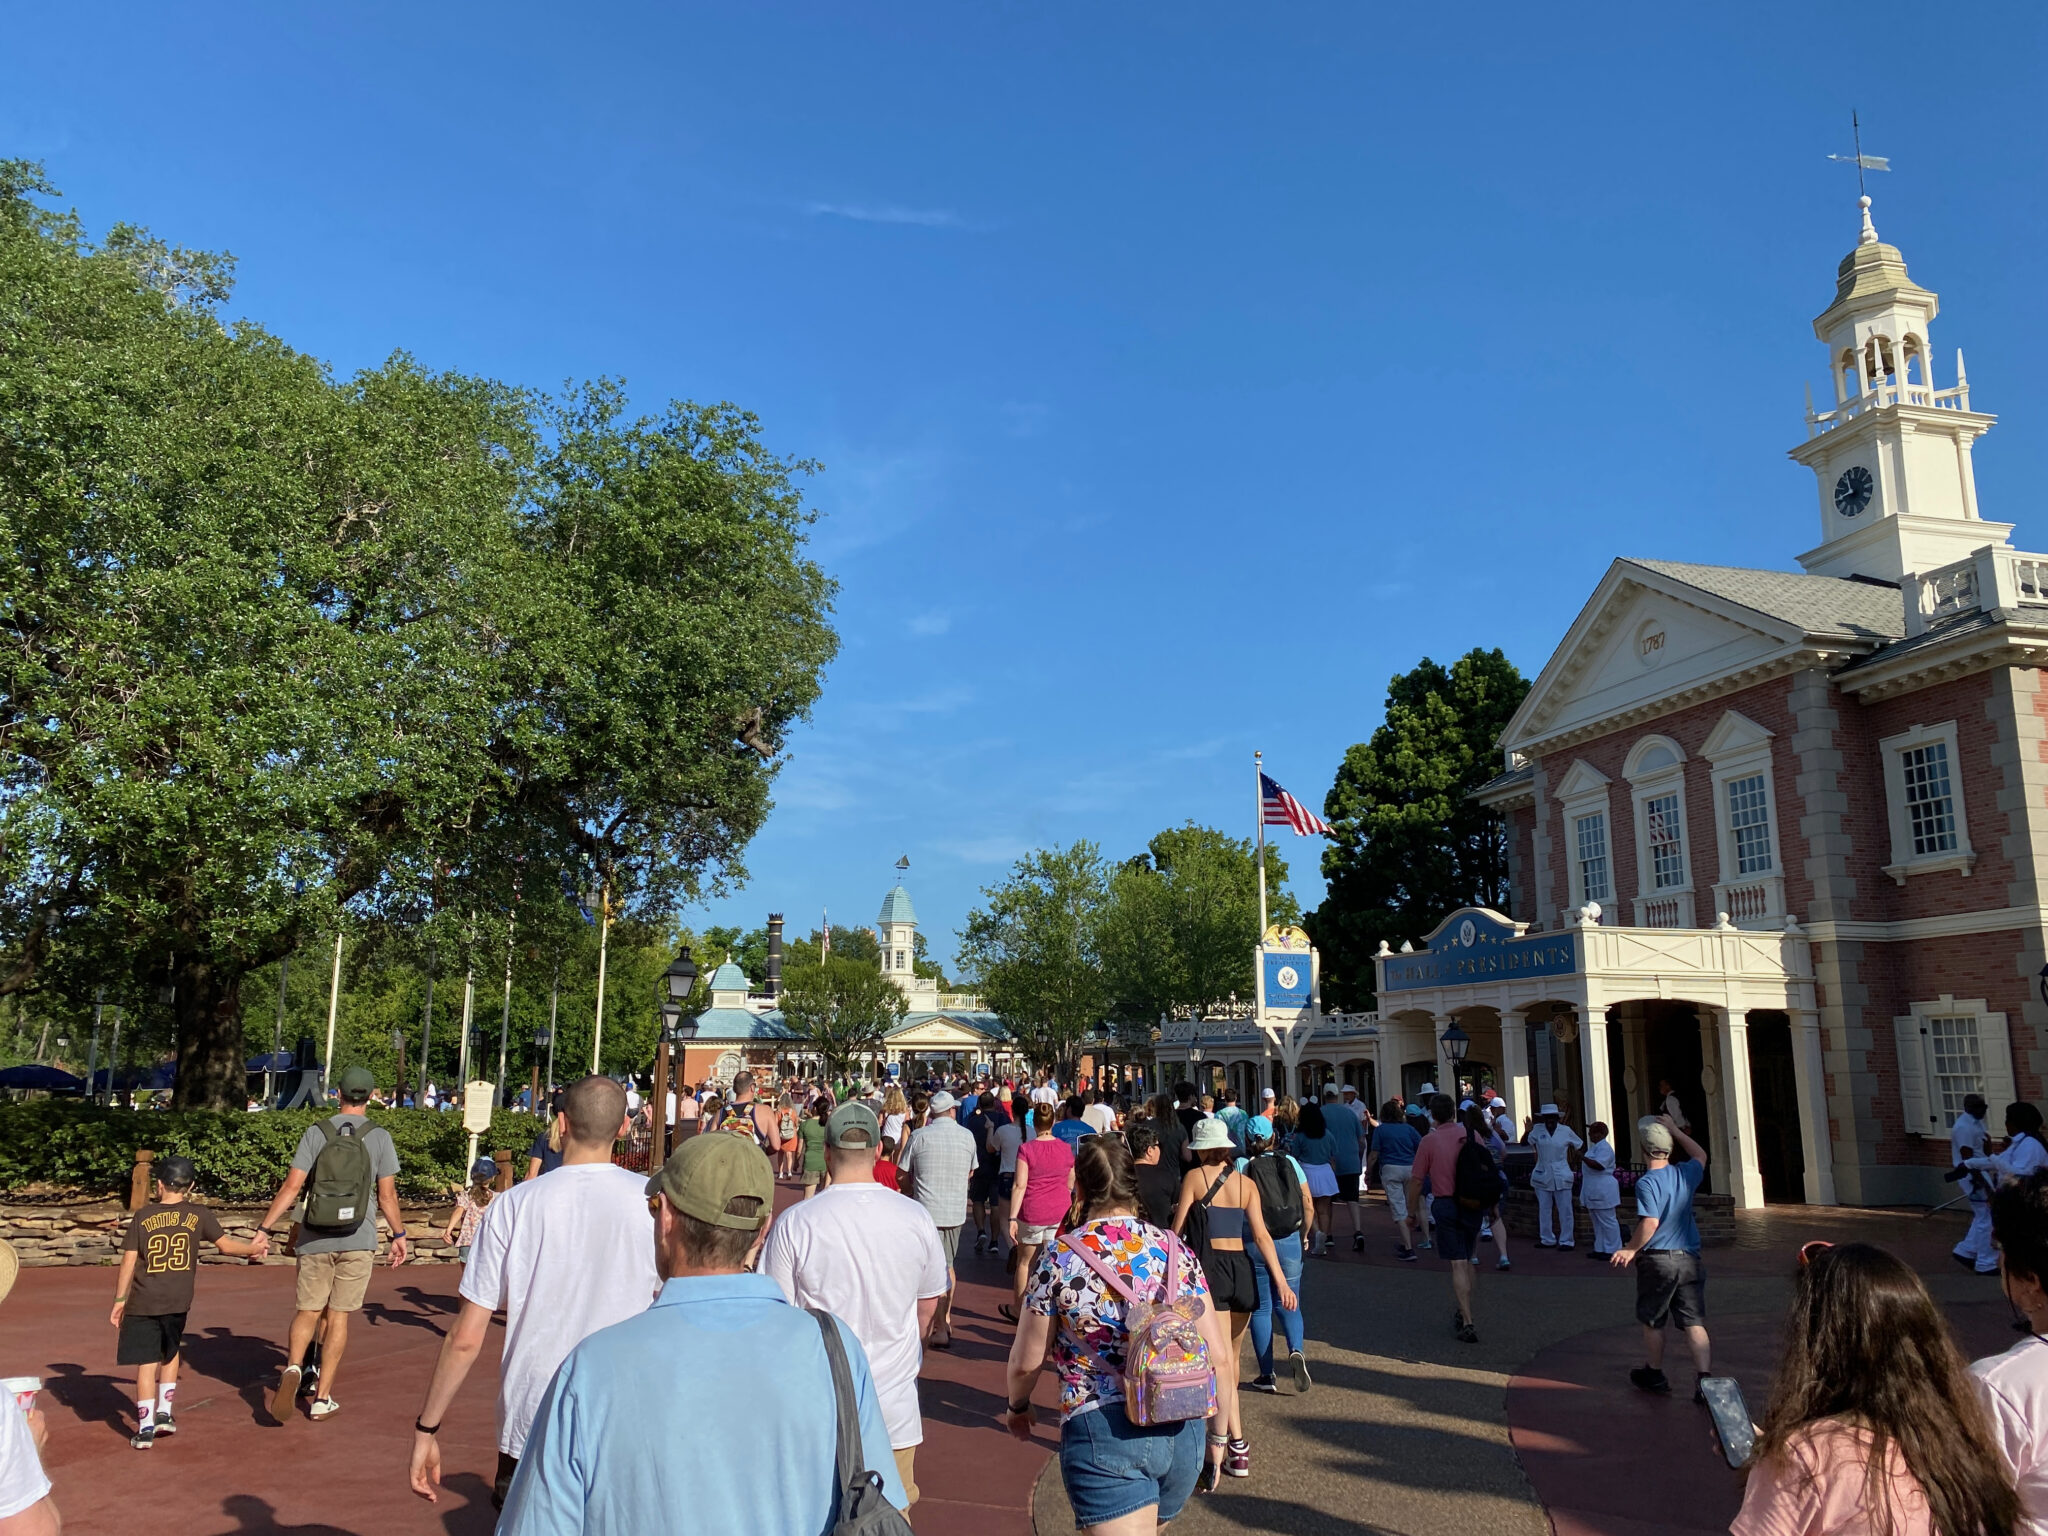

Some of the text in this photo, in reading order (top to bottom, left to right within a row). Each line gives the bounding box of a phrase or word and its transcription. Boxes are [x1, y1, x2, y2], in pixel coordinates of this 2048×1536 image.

[1642, 631, 1665, 656] 1787
[1405, 963, 1441, 981] HALL
[1457, 945, 1569, 976] PRESIDENTS
[141, 1211, 180, 1232] TATIS
[147, 1232, 190, 1273] 23
